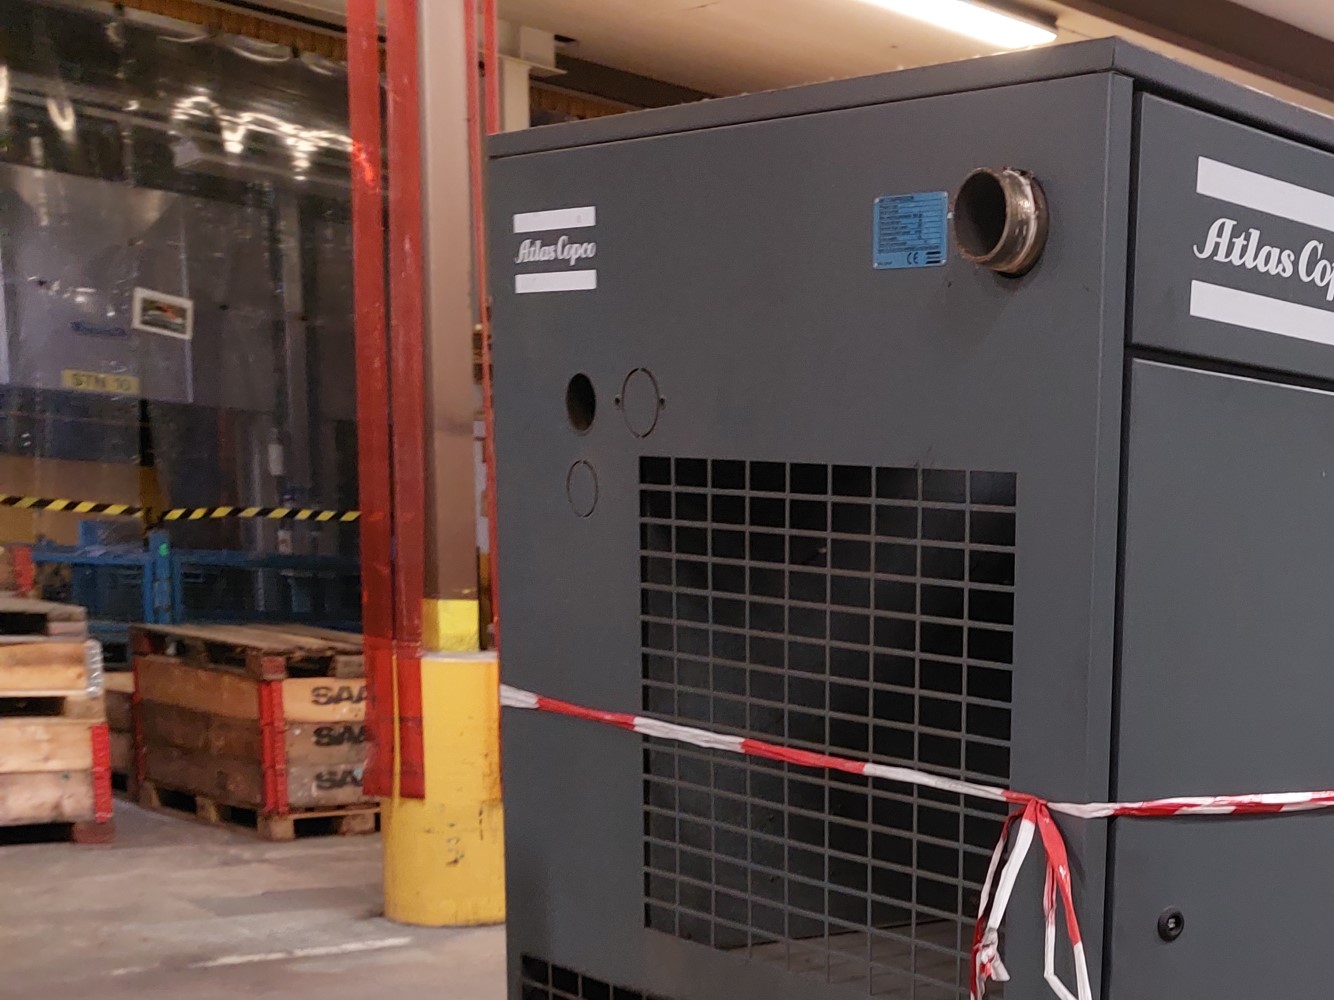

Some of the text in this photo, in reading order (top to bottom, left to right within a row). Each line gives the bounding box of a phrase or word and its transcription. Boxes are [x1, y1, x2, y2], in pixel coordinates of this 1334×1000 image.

[514, 235, 597, 266] Atlas Copco
[1193, 217, 1295, 278] Atlas
